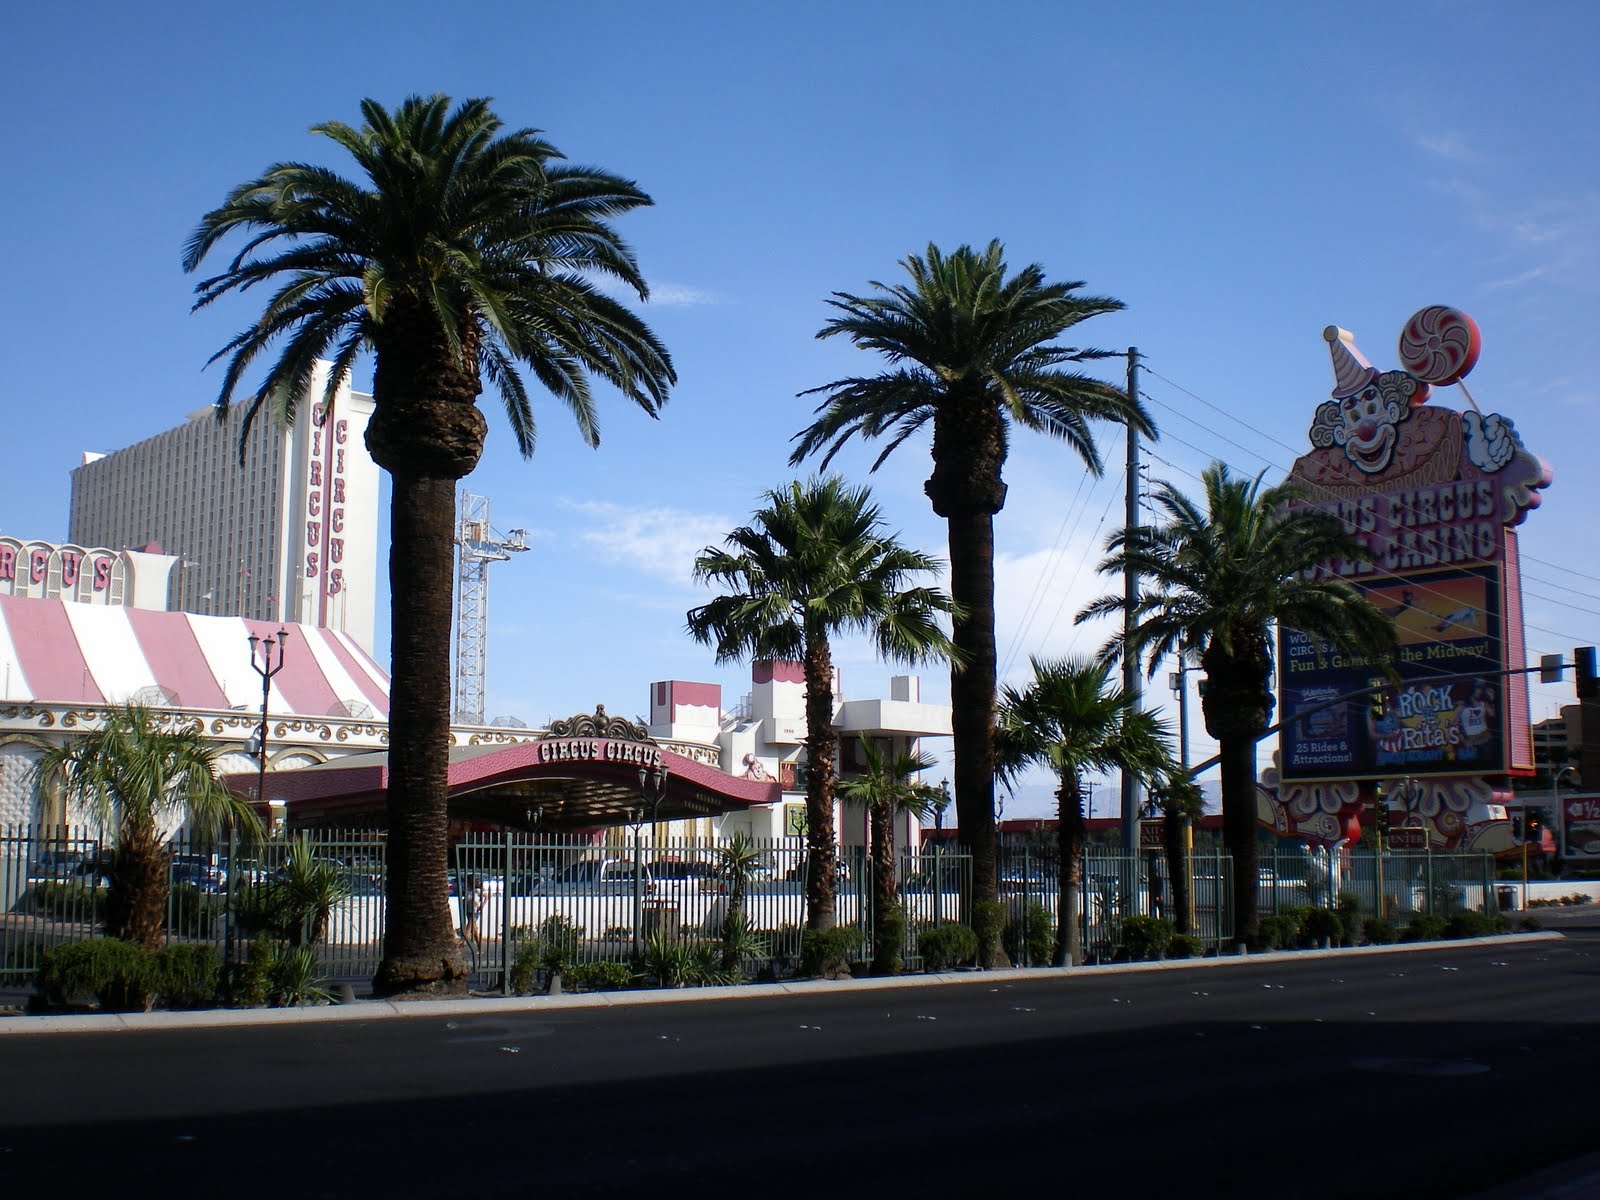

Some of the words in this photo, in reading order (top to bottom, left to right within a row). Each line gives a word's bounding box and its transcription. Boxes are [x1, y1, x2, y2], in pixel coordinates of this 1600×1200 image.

[306, 402, 324, 578] CIRCUS
[1387, 479, 1495, 530] CIRCUS
[330, 419, 348, 595] CIRCUS
[1384, 521, 1496, 569] CASINO
[1290, 643, 1328, 656] CIRCS
[1290, 659, 1315, 672] Fun
[1401, 647, 1424, 661] the
[1426, 641, 1489, 660] Midway!
[1398, 684, 1457, 718] ROCK
[1296, 743, 1309, 753] 25
[1311, 741, 1338, 752] Rides
[1339, 741, 1348, 752] &
[1402, 719, 1460, 750] Rita's
[539, 741, 599, 762] CIRCUS
[605, 742, 662, 767] CIRCUS
[1293, 750, 1353, 765] Attractions!
[1391, 834, 1424, 844] ENTER
